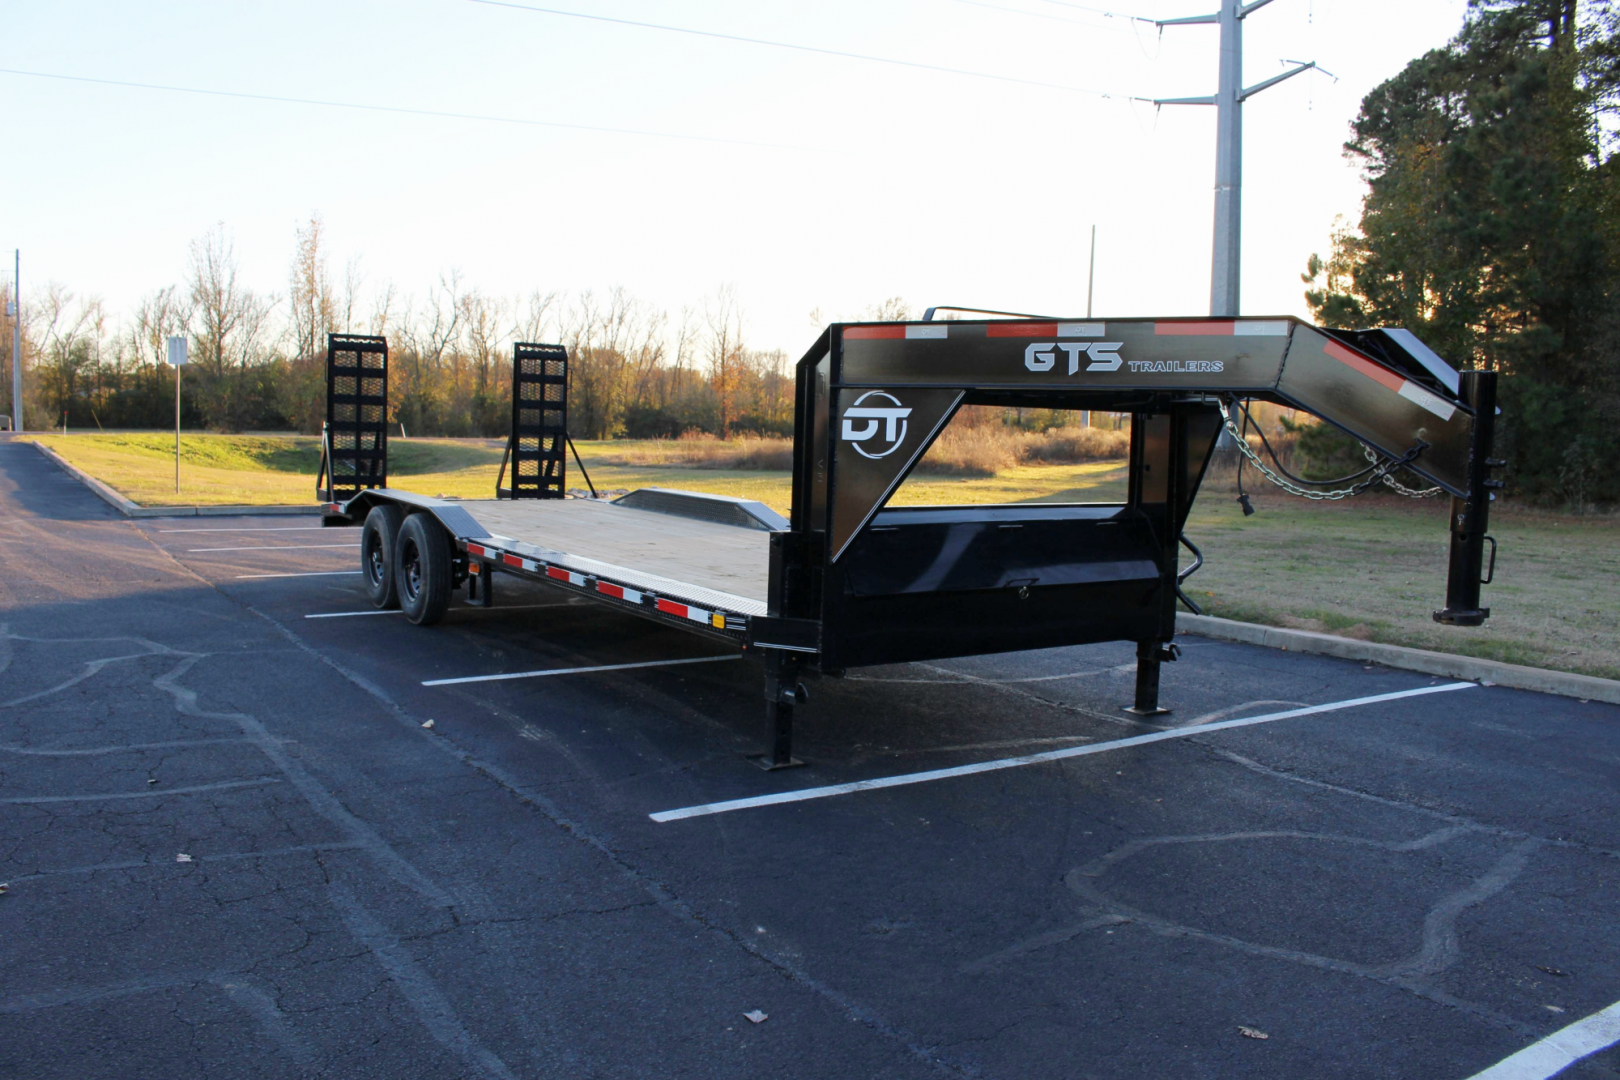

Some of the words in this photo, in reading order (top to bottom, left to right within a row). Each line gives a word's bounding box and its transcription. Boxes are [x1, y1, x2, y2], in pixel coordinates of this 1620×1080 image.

[1024, 342, 1124, 376] GTS
[1128, 360, 1224, 373] TRAILERS
[841, 407, 913, 442] DT
